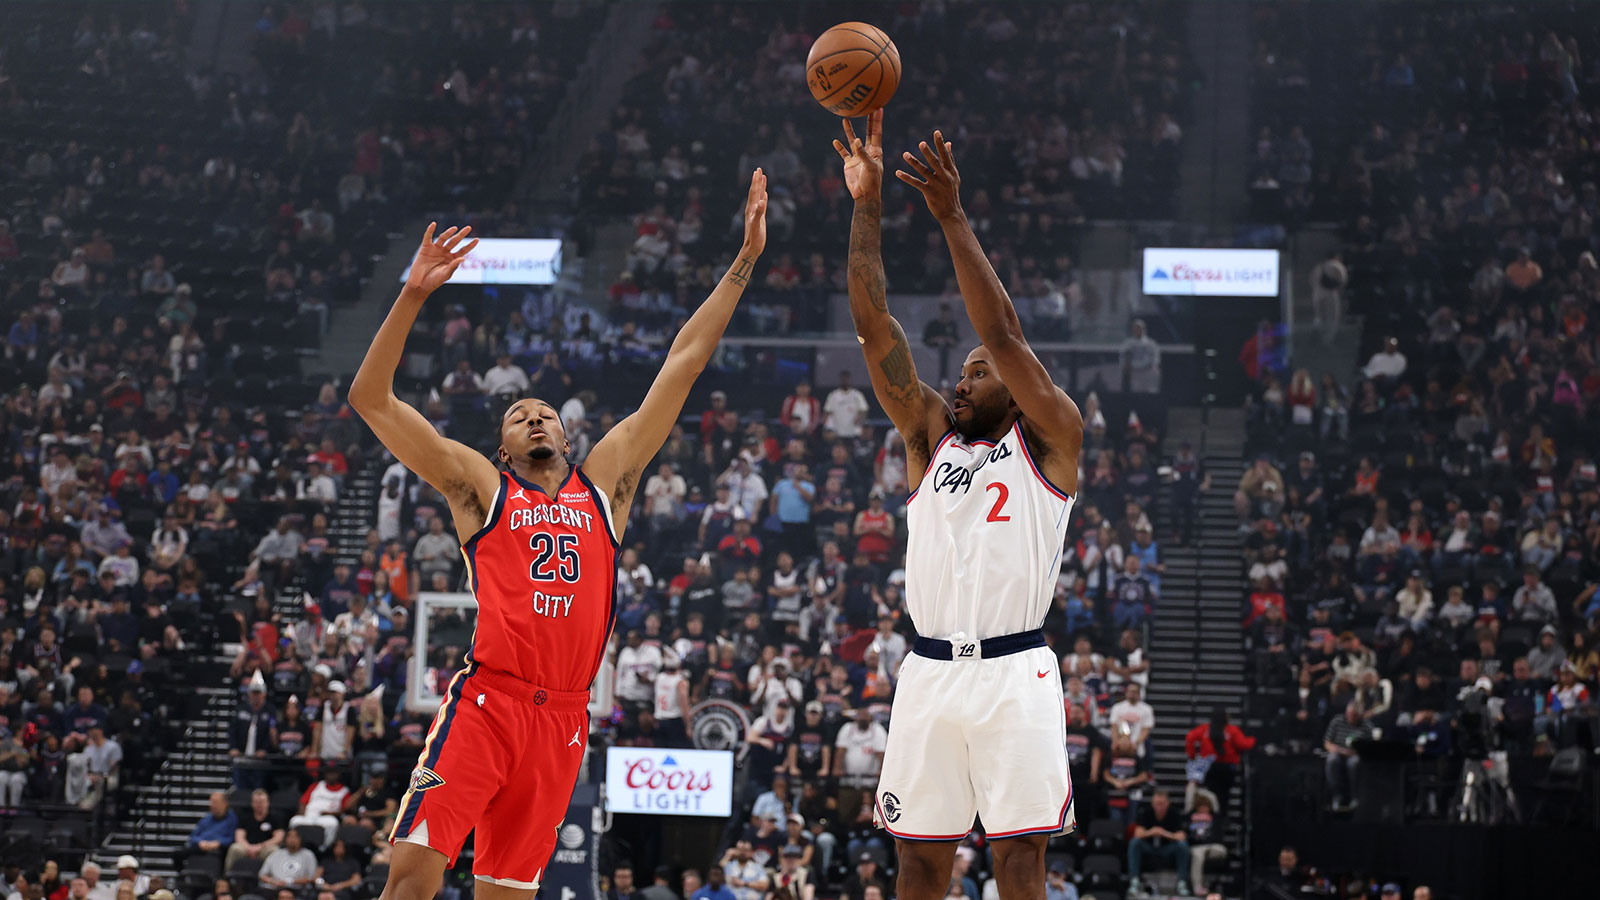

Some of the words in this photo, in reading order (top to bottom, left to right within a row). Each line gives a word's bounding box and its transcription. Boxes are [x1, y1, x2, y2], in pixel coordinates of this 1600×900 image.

[1171, 262, 1223, 281] Coors
[1225, 268, 1273, 282] LIGHT
[933, 442, 1012, 494] Cliprs
[560, 491, 590, 499] NEWAGE
[986, 481, 1011, 522] 2
[510, 504, 593, 532] CRESCENT
[529, 531, 580, 584] 25
[533, 590, 575, 618] CITY
[625, 757, 713, 791] Coors
[633, 793, 703, 811] LIGHT
